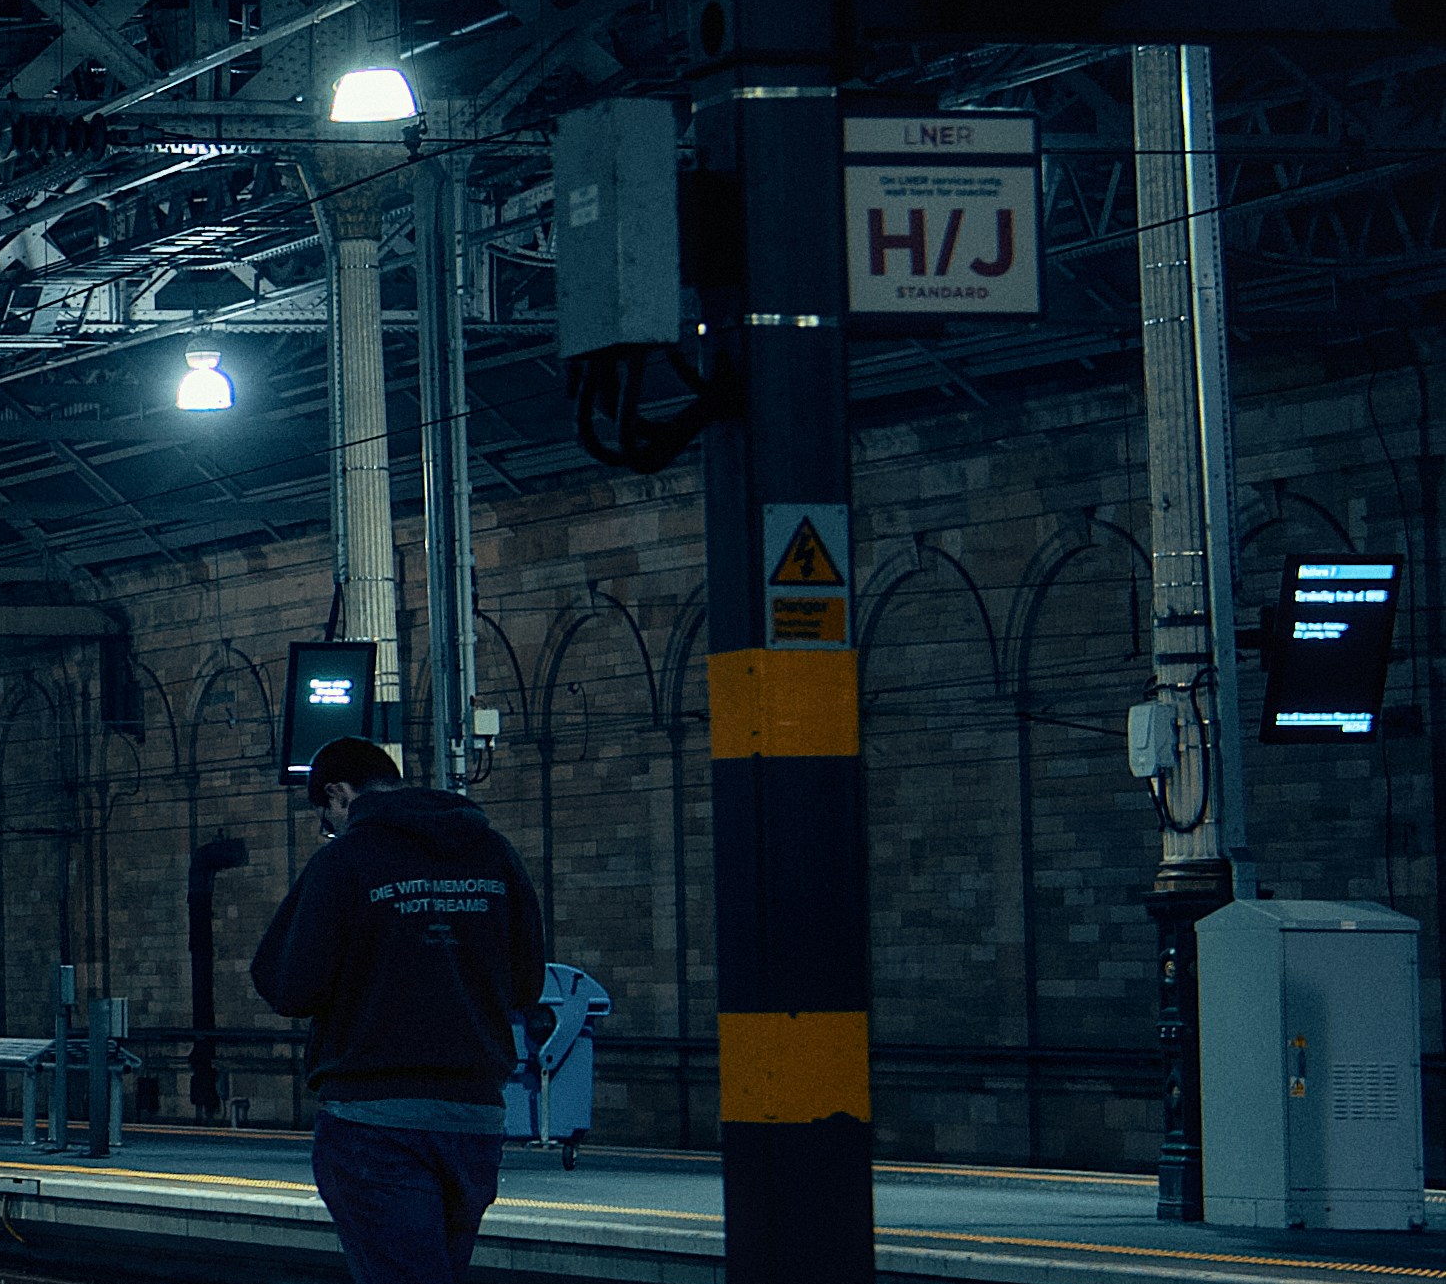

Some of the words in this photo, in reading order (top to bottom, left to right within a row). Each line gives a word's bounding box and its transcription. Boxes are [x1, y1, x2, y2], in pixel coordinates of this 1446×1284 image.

[904, 124, 974, 146] LNER
[867, 208, 1014, 278] H/J
[896, 286, 990, 300] STANDARD
[774, 599, 827, 615] Danger
[369, 884, 395, 903] DIE
[433, 878, 506, 896] MEMORIES
